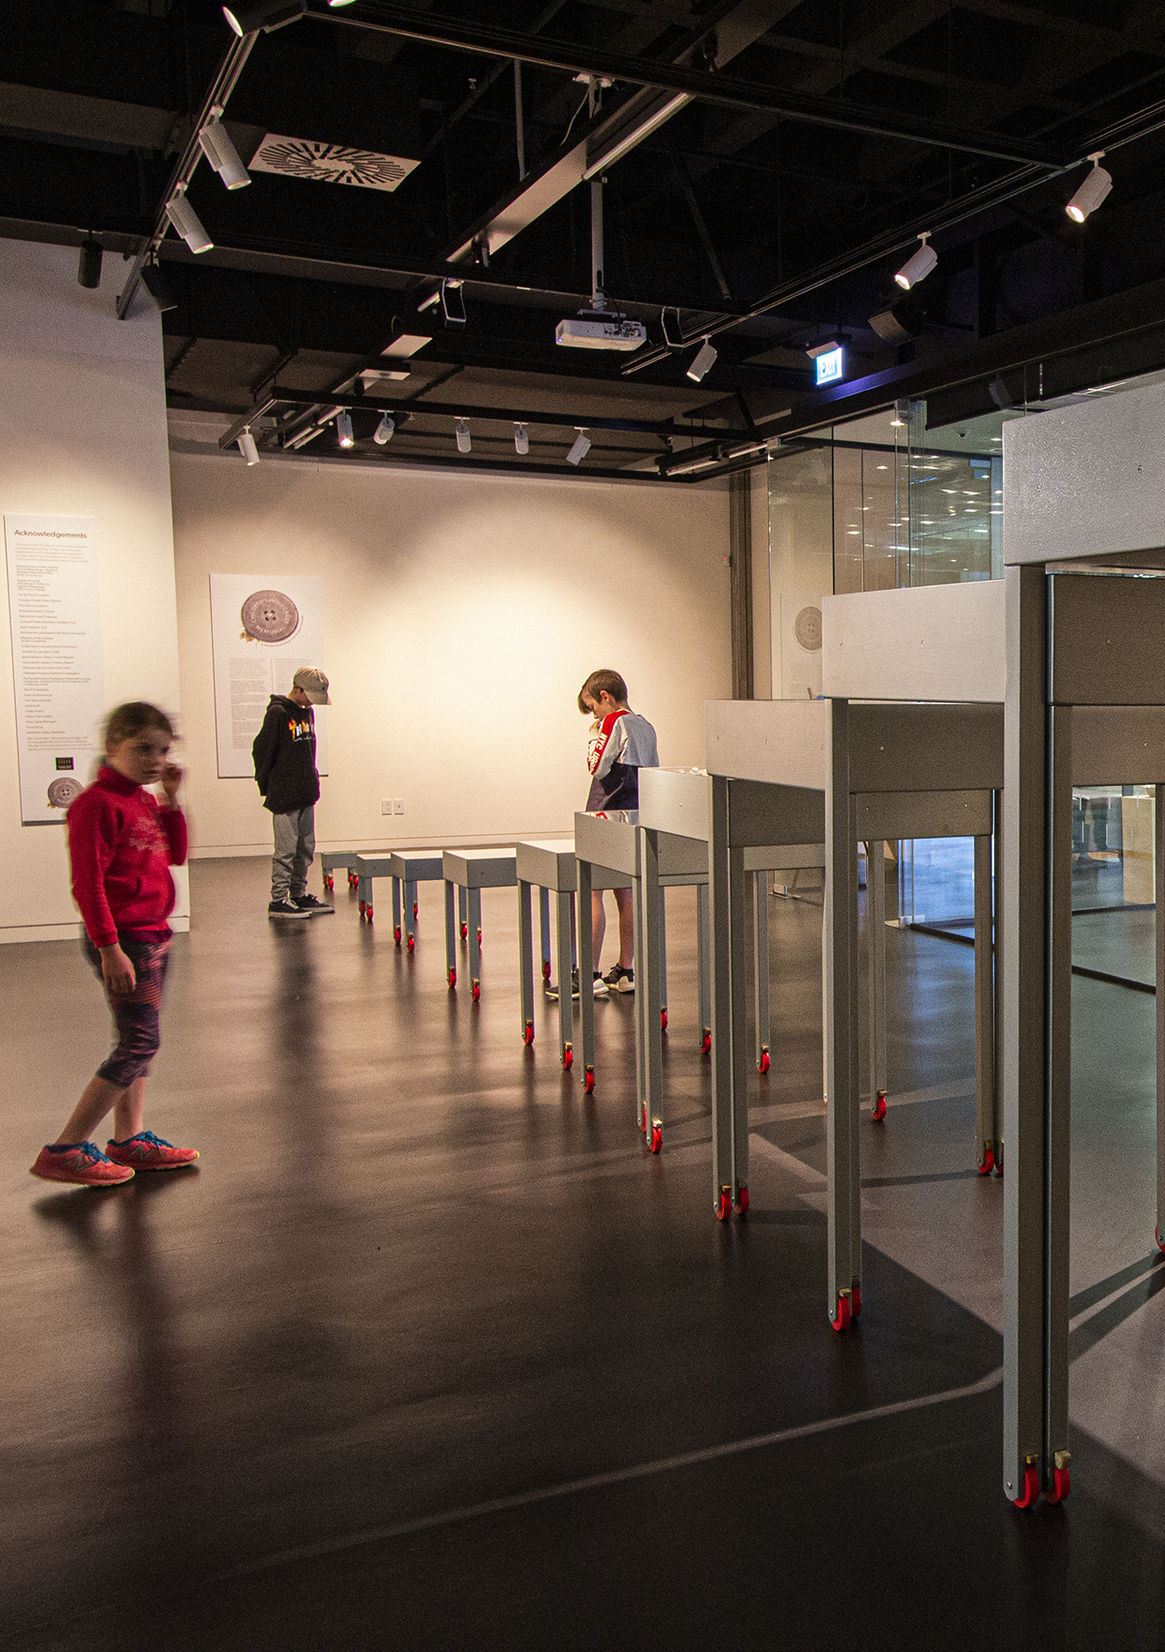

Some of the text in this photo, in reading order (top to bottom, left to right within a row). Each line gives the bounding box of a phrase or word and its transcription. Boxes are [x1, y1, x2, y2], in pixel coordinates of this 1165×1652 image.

[819, 355, 839, 378] EXIT
[14, 529, 88, 539] Acknowledgements
[596, 733, 608, 750] NYC
